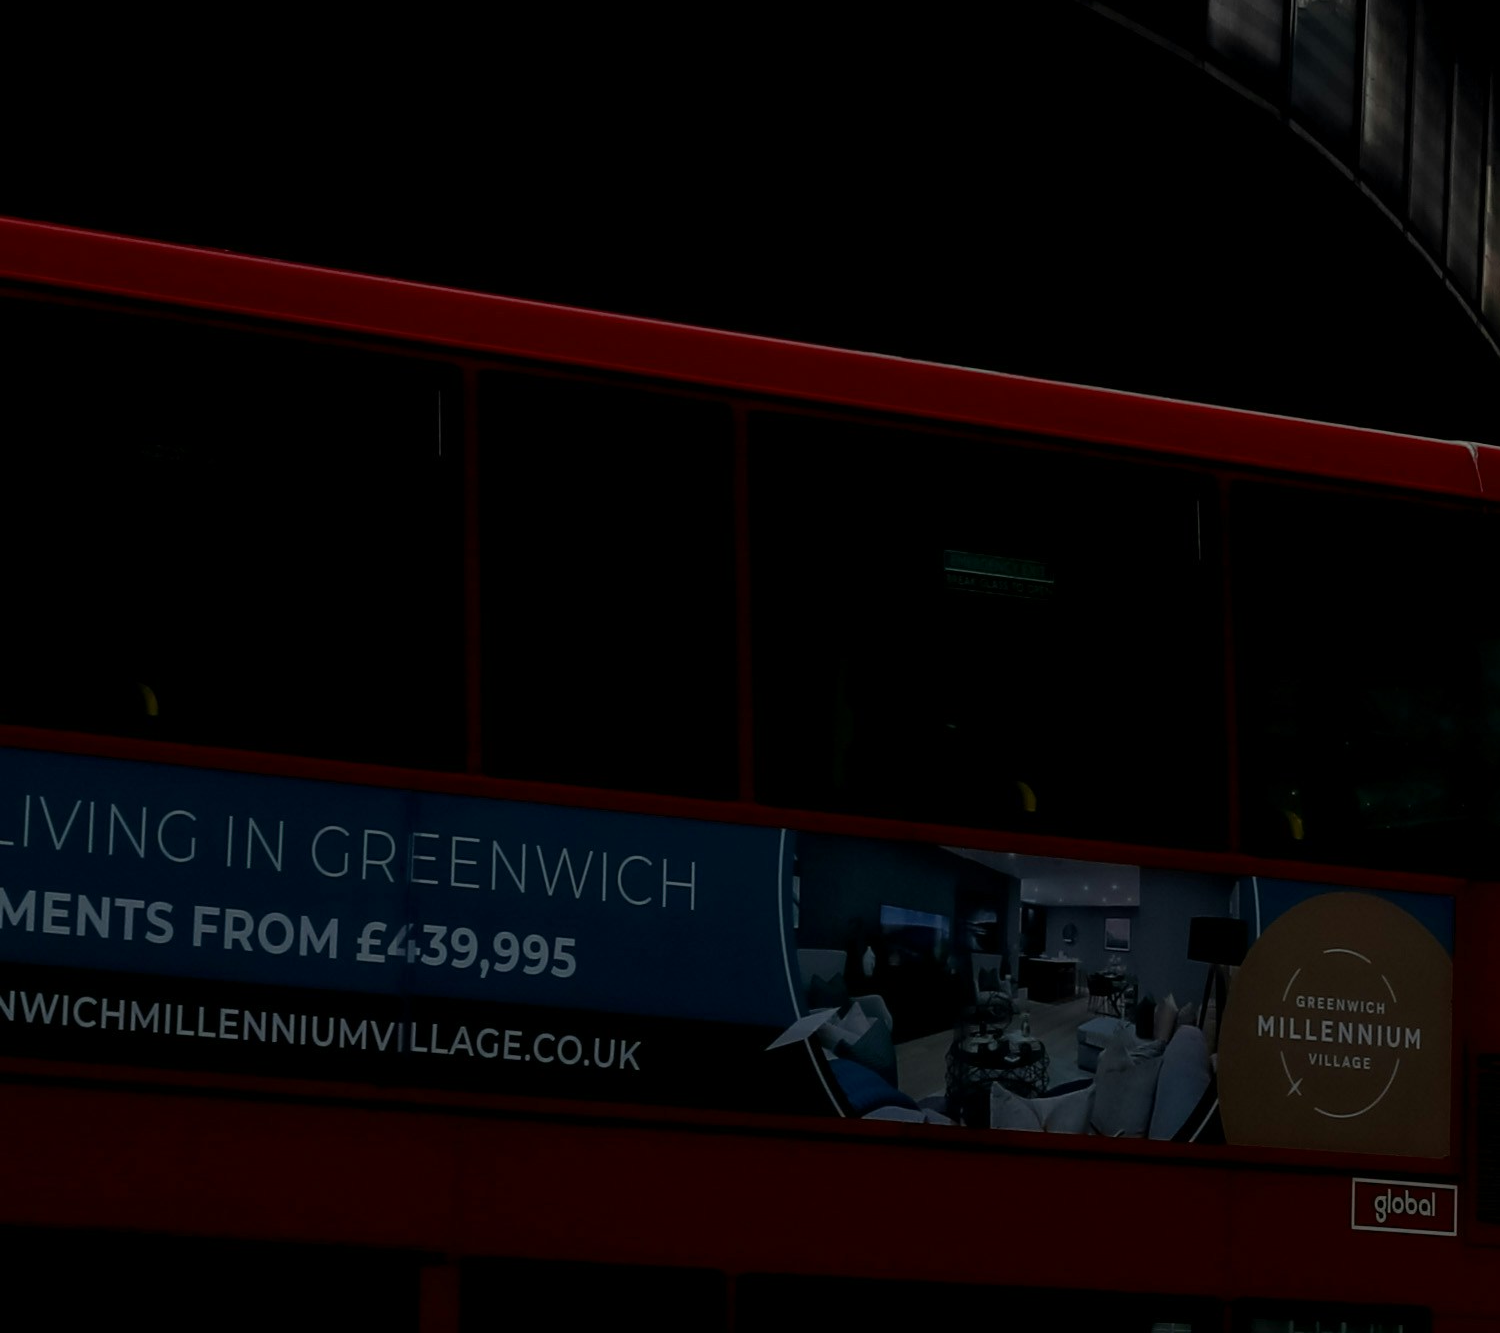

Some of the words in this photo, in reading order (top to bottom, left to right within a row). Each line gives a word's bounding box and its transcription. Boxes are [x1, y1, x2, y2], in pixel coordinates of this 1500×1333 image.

[226, 815, 285, 872] IN
[311, 825, 697, 911] GREENWICH
[192, 905, 339, 959] FROM
[355, 920, 577, 979] £439,995
[1296, 994, 1386, 1015] GREENWICH
[1257, 1014, 1421, 1050] MILLENNIUM
[1308, 1052, 1371, 1070] VILLAGE
[1374, 1188, 1436, 1223] global
